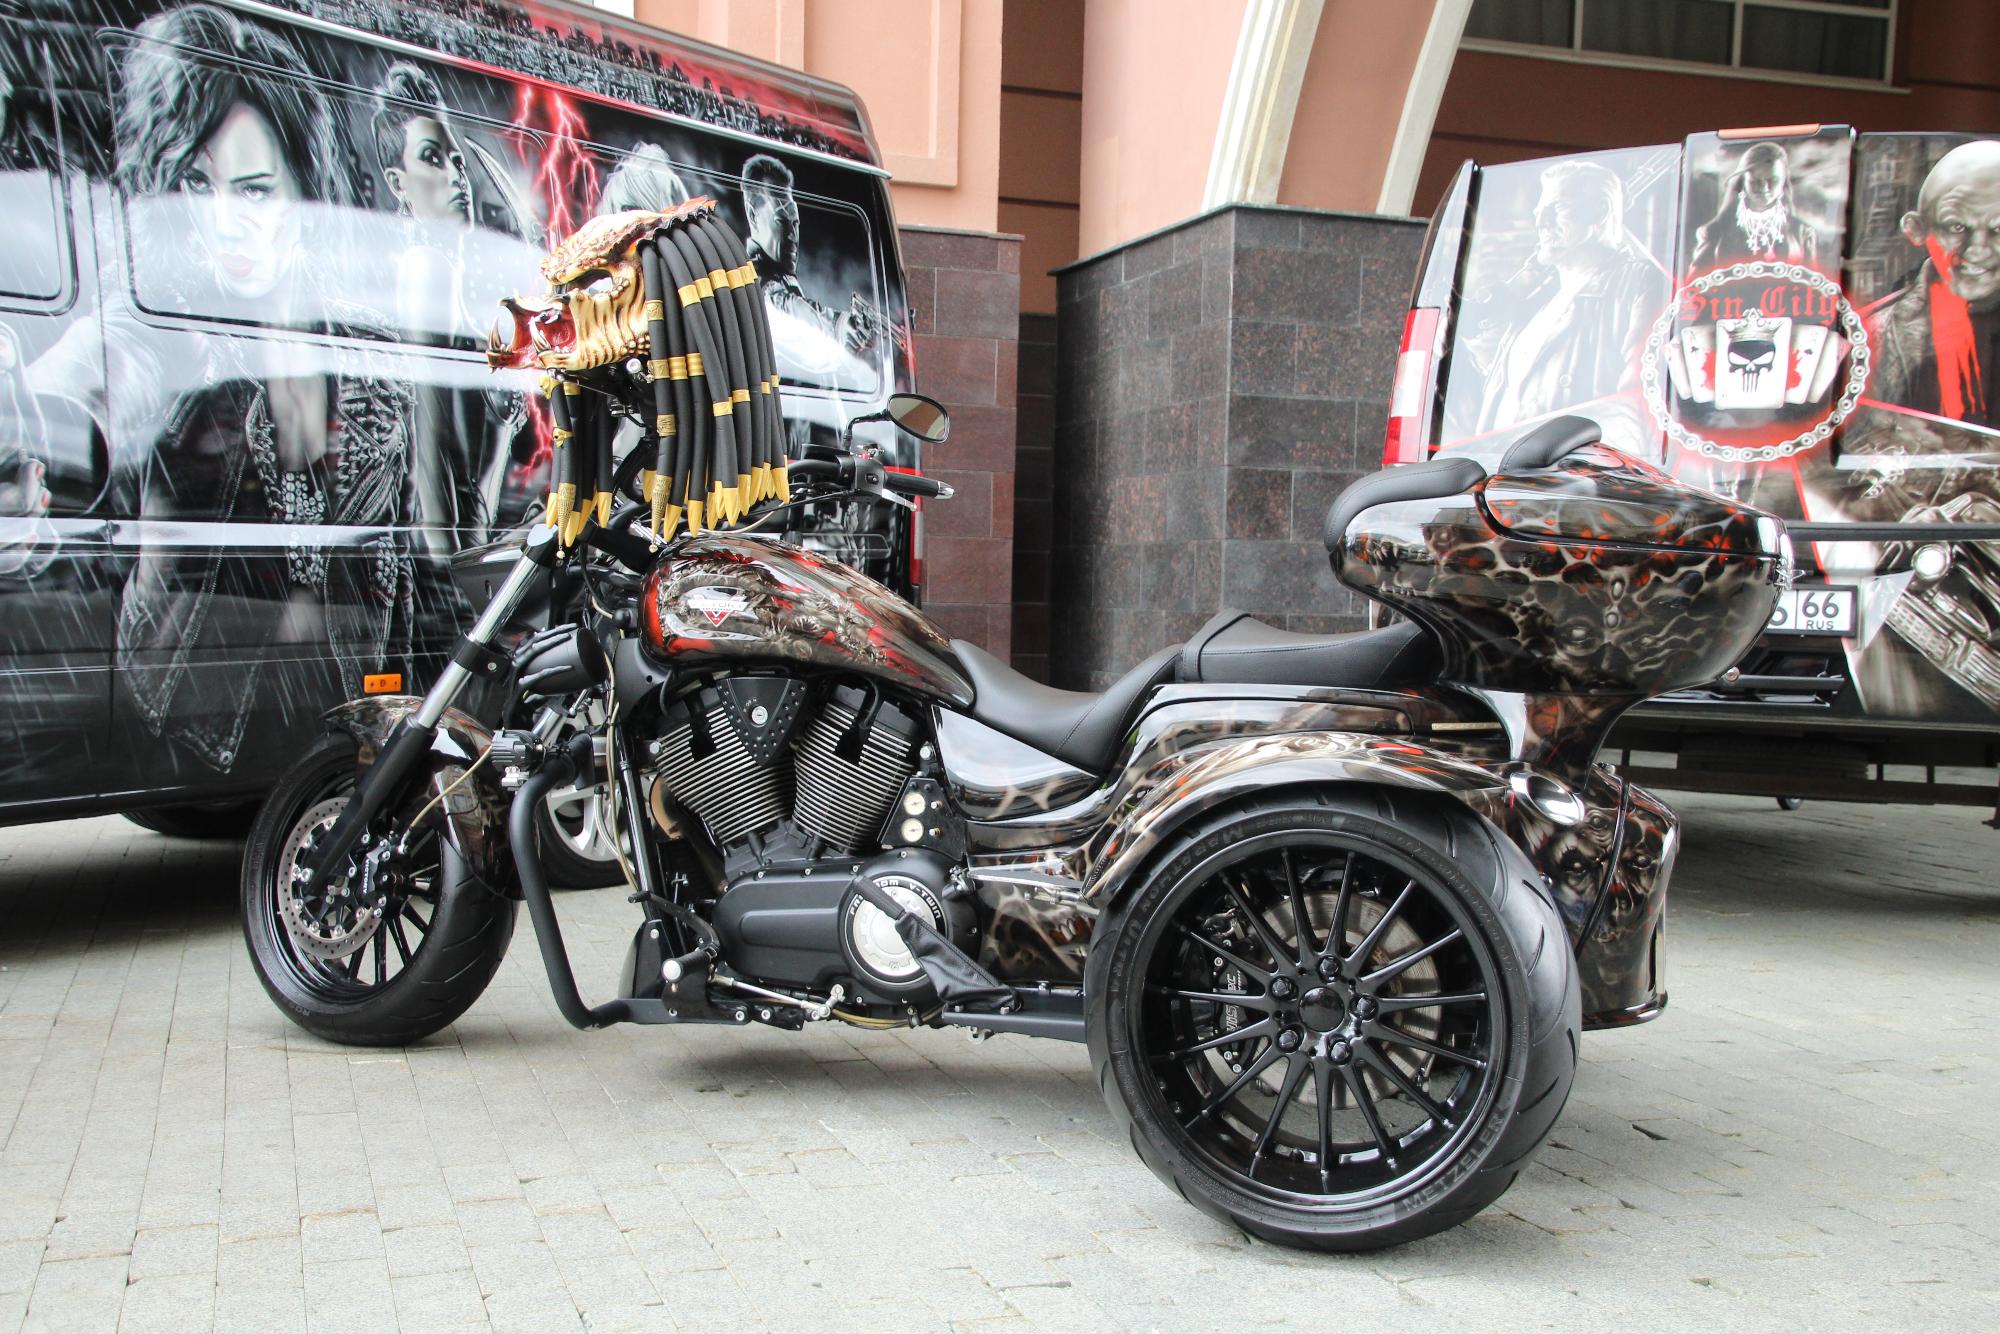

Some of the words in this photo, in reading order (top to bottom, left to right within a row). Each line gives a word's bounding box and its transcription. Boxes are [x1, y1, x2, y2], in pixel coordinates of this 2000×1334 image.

[1680, 287, 1743, 321] Sin
[1760, 285, 1840, 325] City
[1802, 591, 1839, 618] 66
[1806, 620, 1834, 630] RUS
[1402, 1112, 1505, 1212] METZELER
